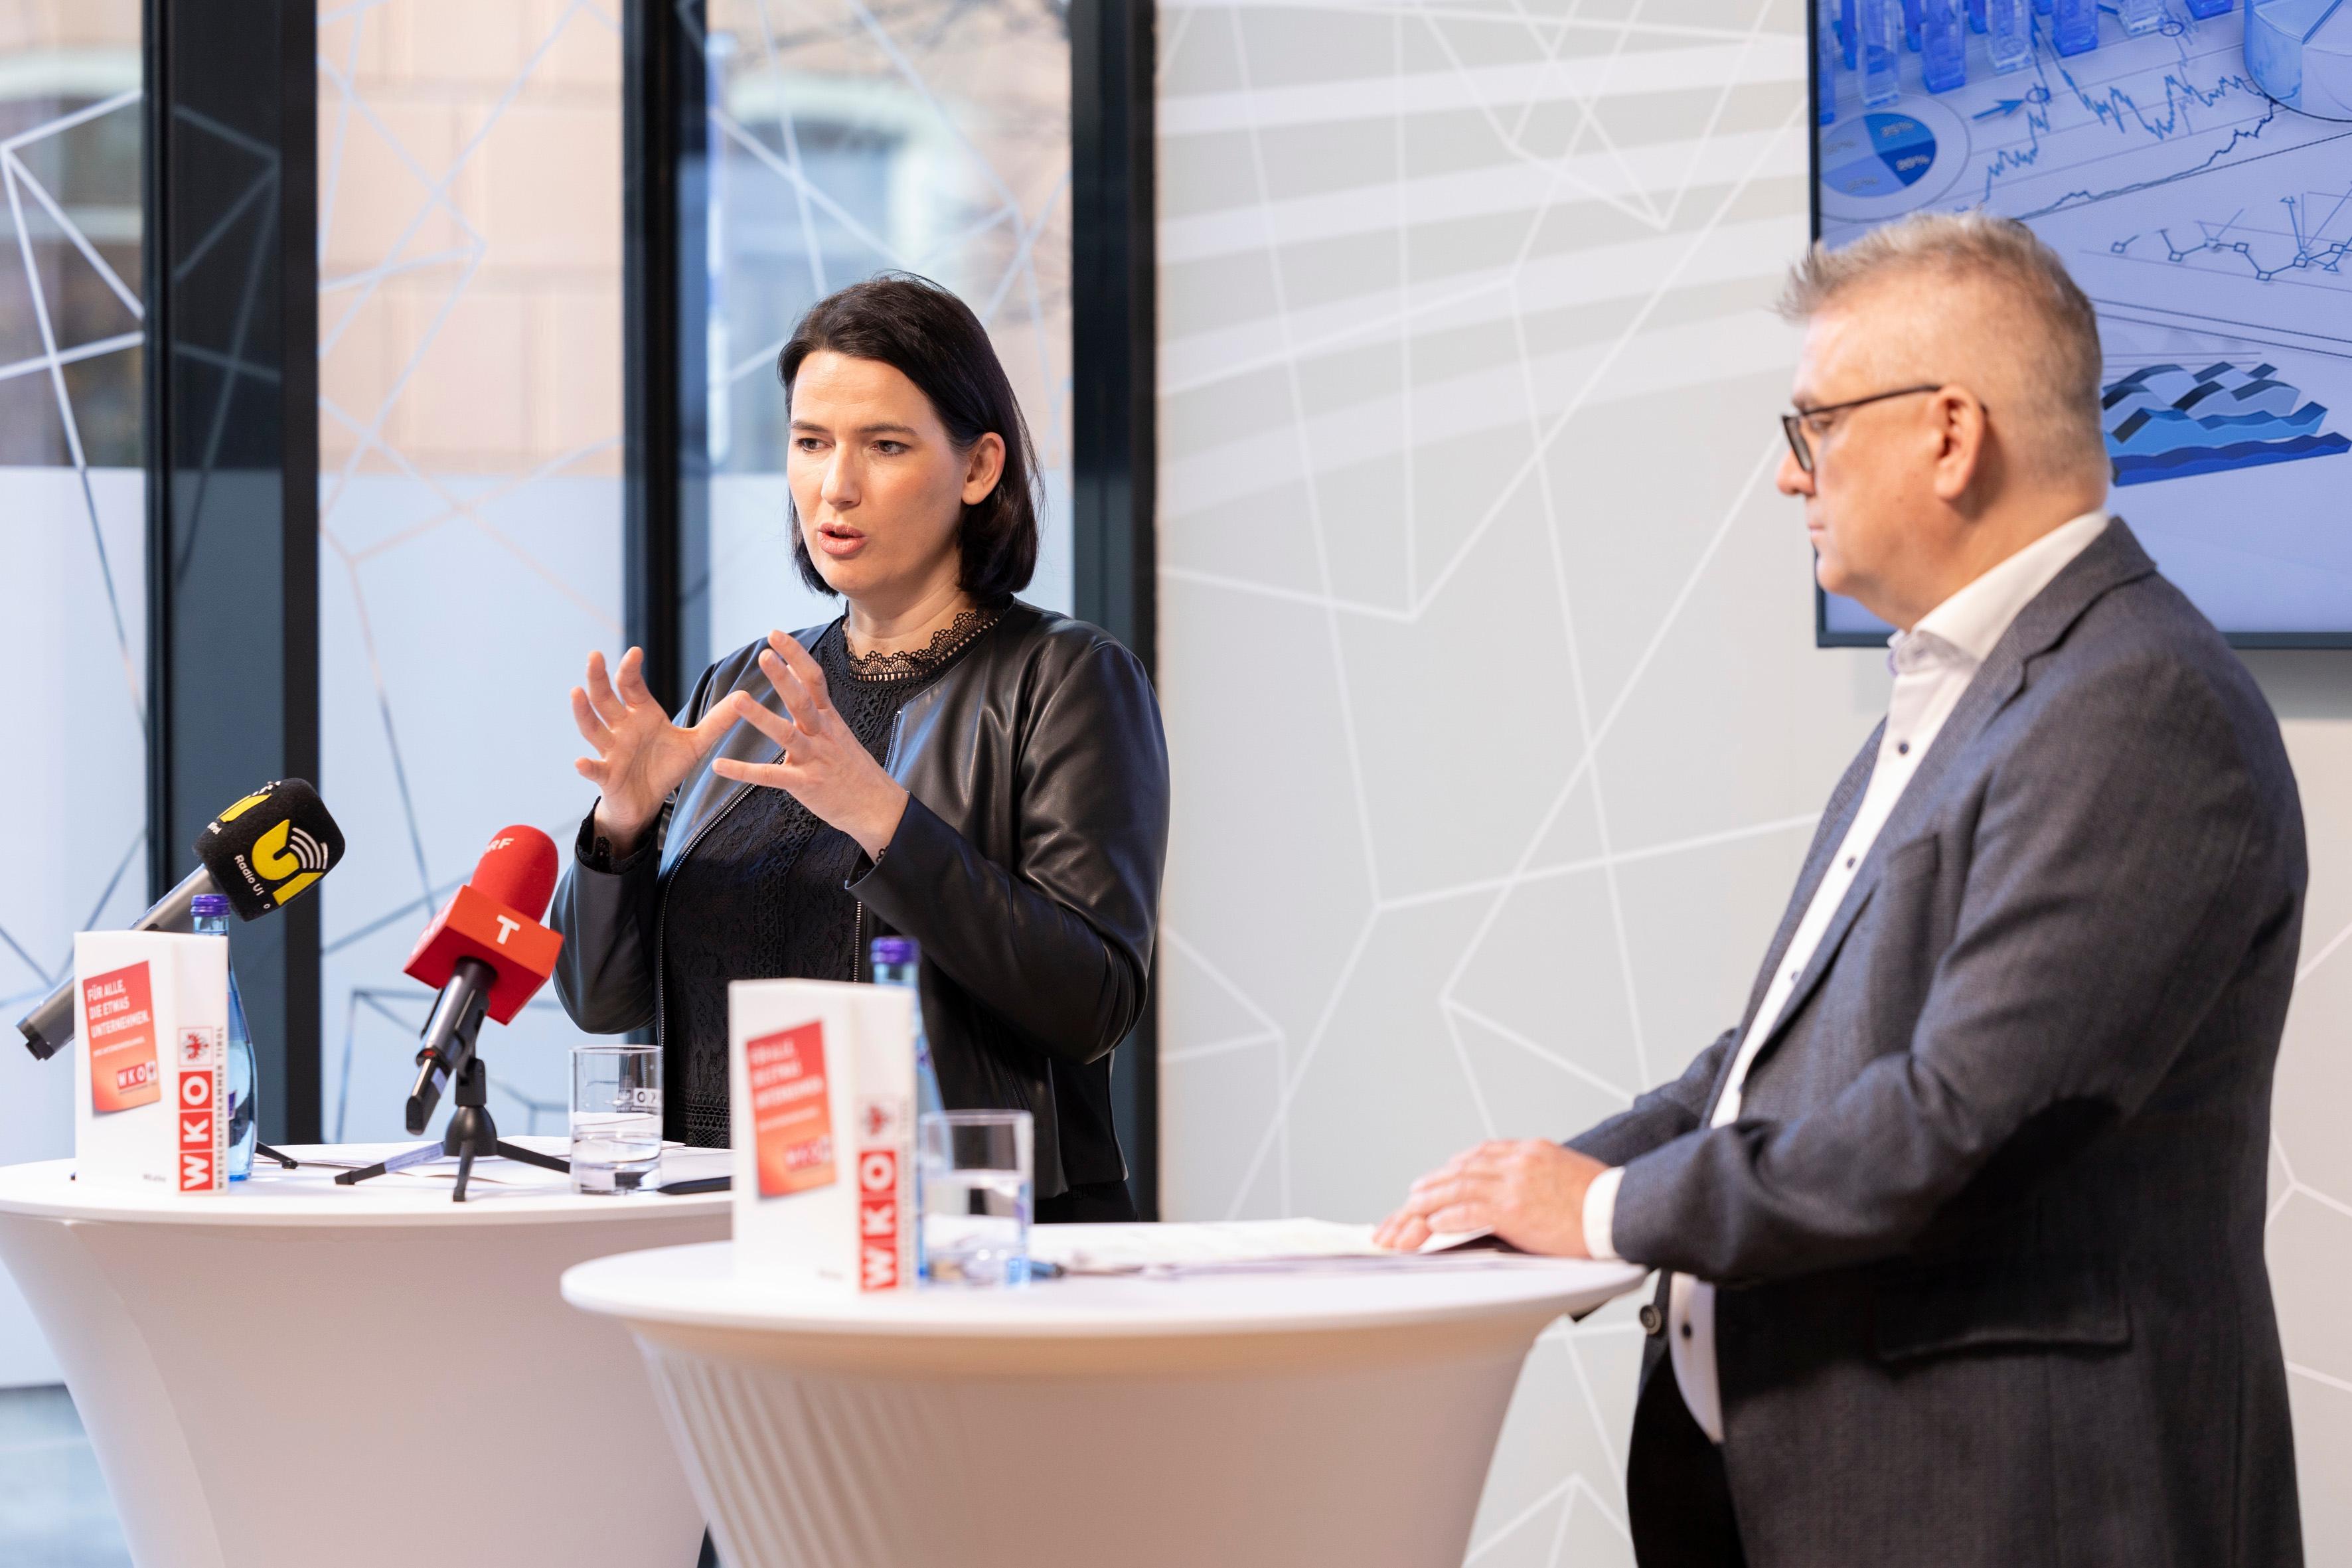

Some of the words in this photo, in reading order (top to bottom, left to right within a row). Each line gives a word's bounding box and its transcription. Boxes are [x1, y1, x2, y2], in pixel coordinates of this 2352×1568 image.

[234, 854, 256, 884] Radio
[252, 883, 265, 897] U1
[497, 914, 521, 945] T
[87, 984, 103, 1002] FÜR
[89, 1004, 102, 1020] DIE
[103, 996, 130, 1016] ETWAS
[118, 1065, 147, 1088] WKO
[182, 1075, 210, 1190] WKO
[862, 1152, 894, 1290] WKO
